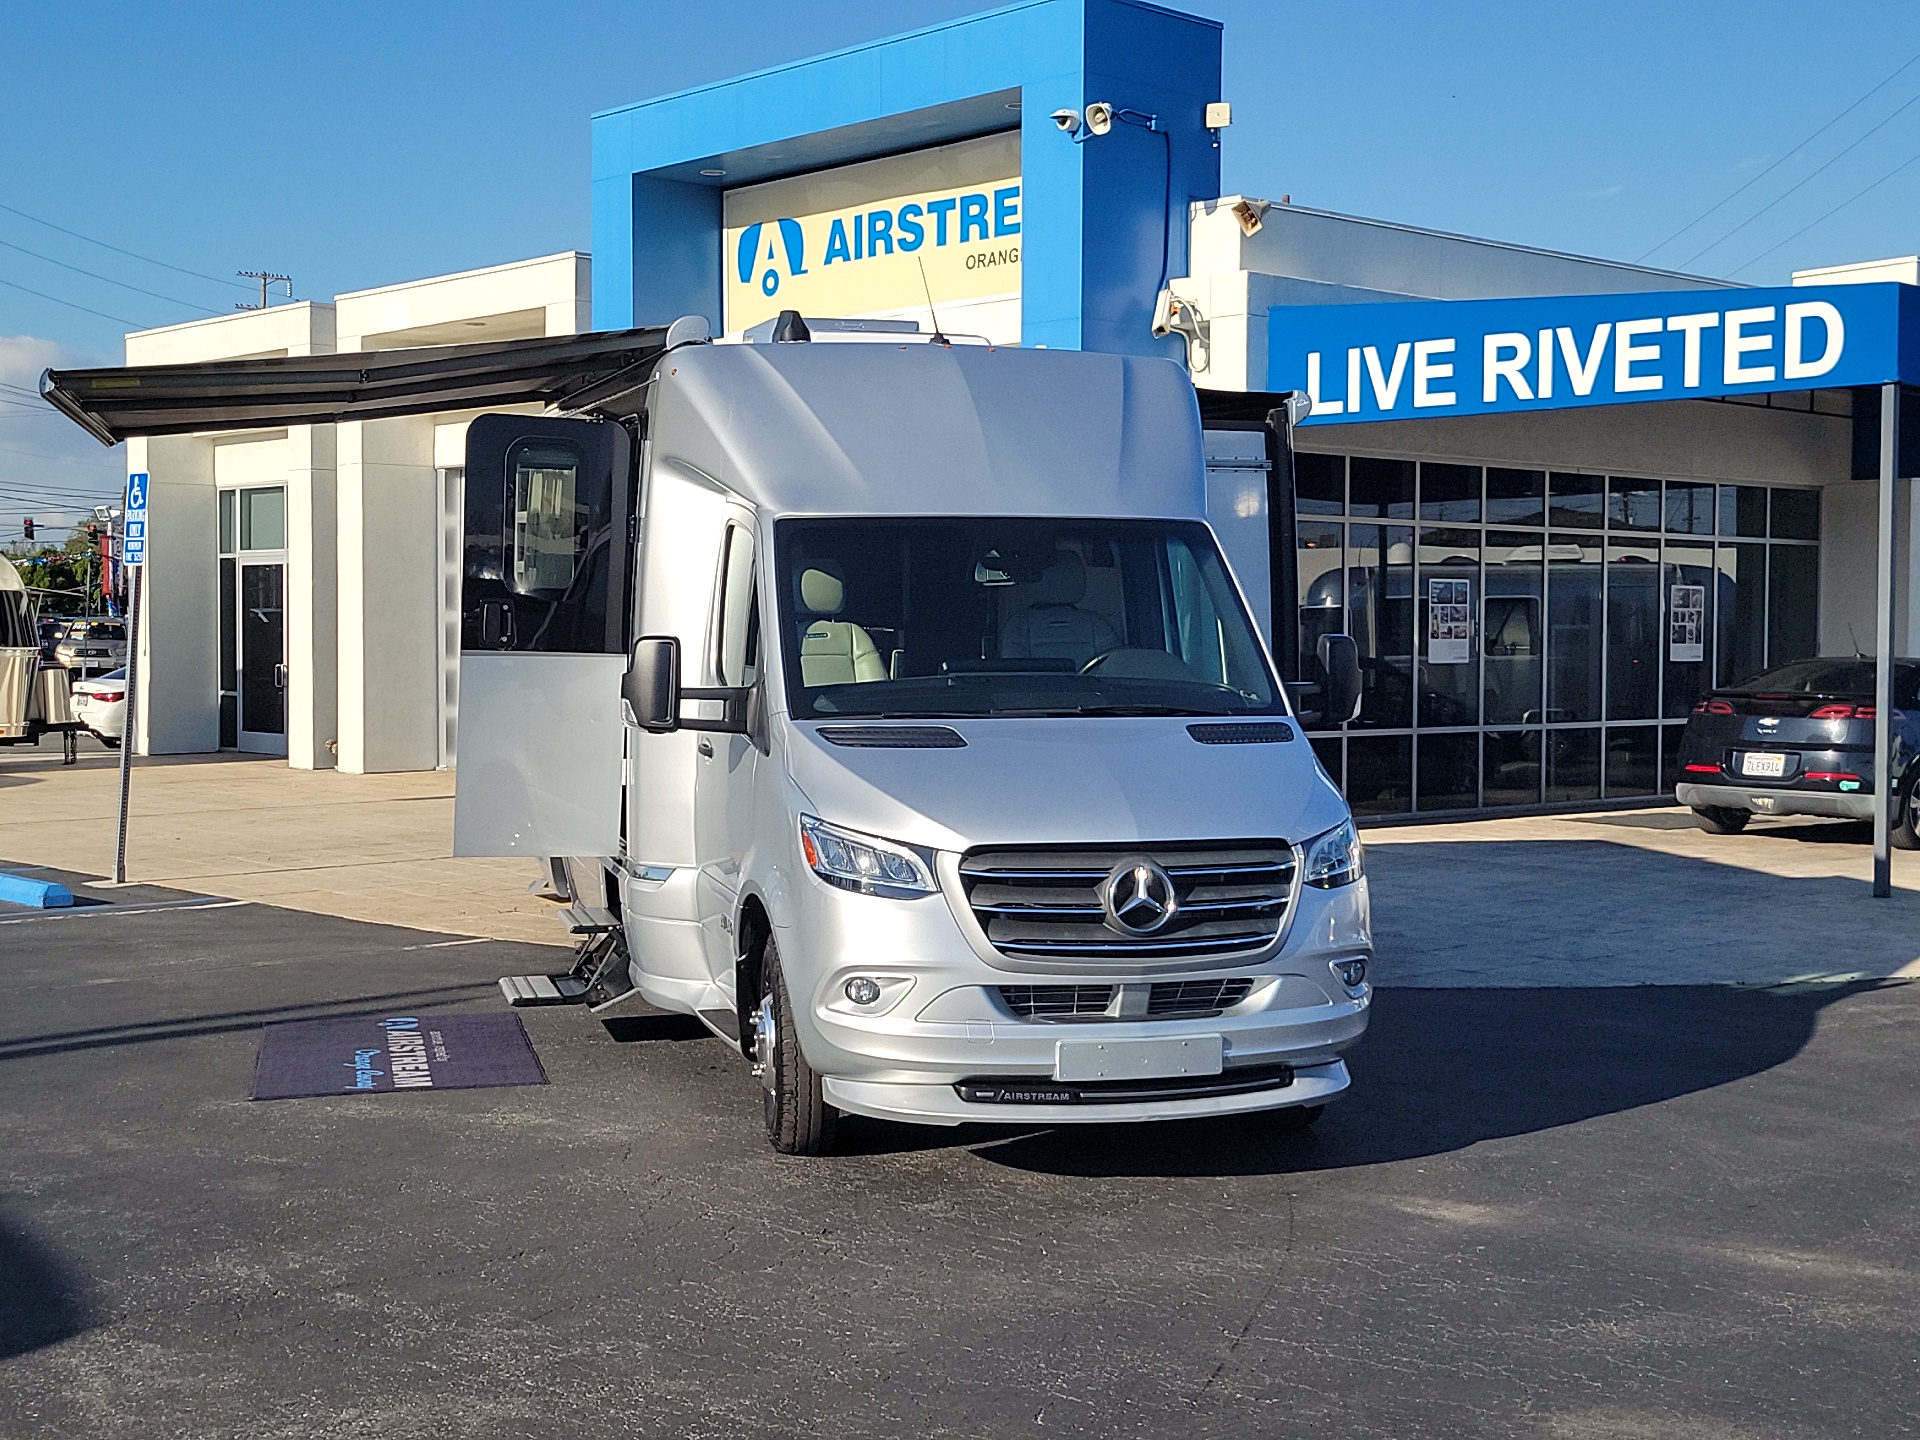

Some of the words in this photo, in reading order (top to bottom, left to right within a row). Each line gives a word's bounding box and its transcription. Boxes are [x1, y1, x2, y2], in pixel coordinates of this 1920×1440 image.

[966, 247, 1022, 270] ORANG
[1307, 338, 1457, 416] LIVE
[1483, 301, 1845, 403] RIVETED
[386, 1030, 434, 1088] AIRSTREAM
[1003, 1091, 1070, 1101] AIRSTREAM
